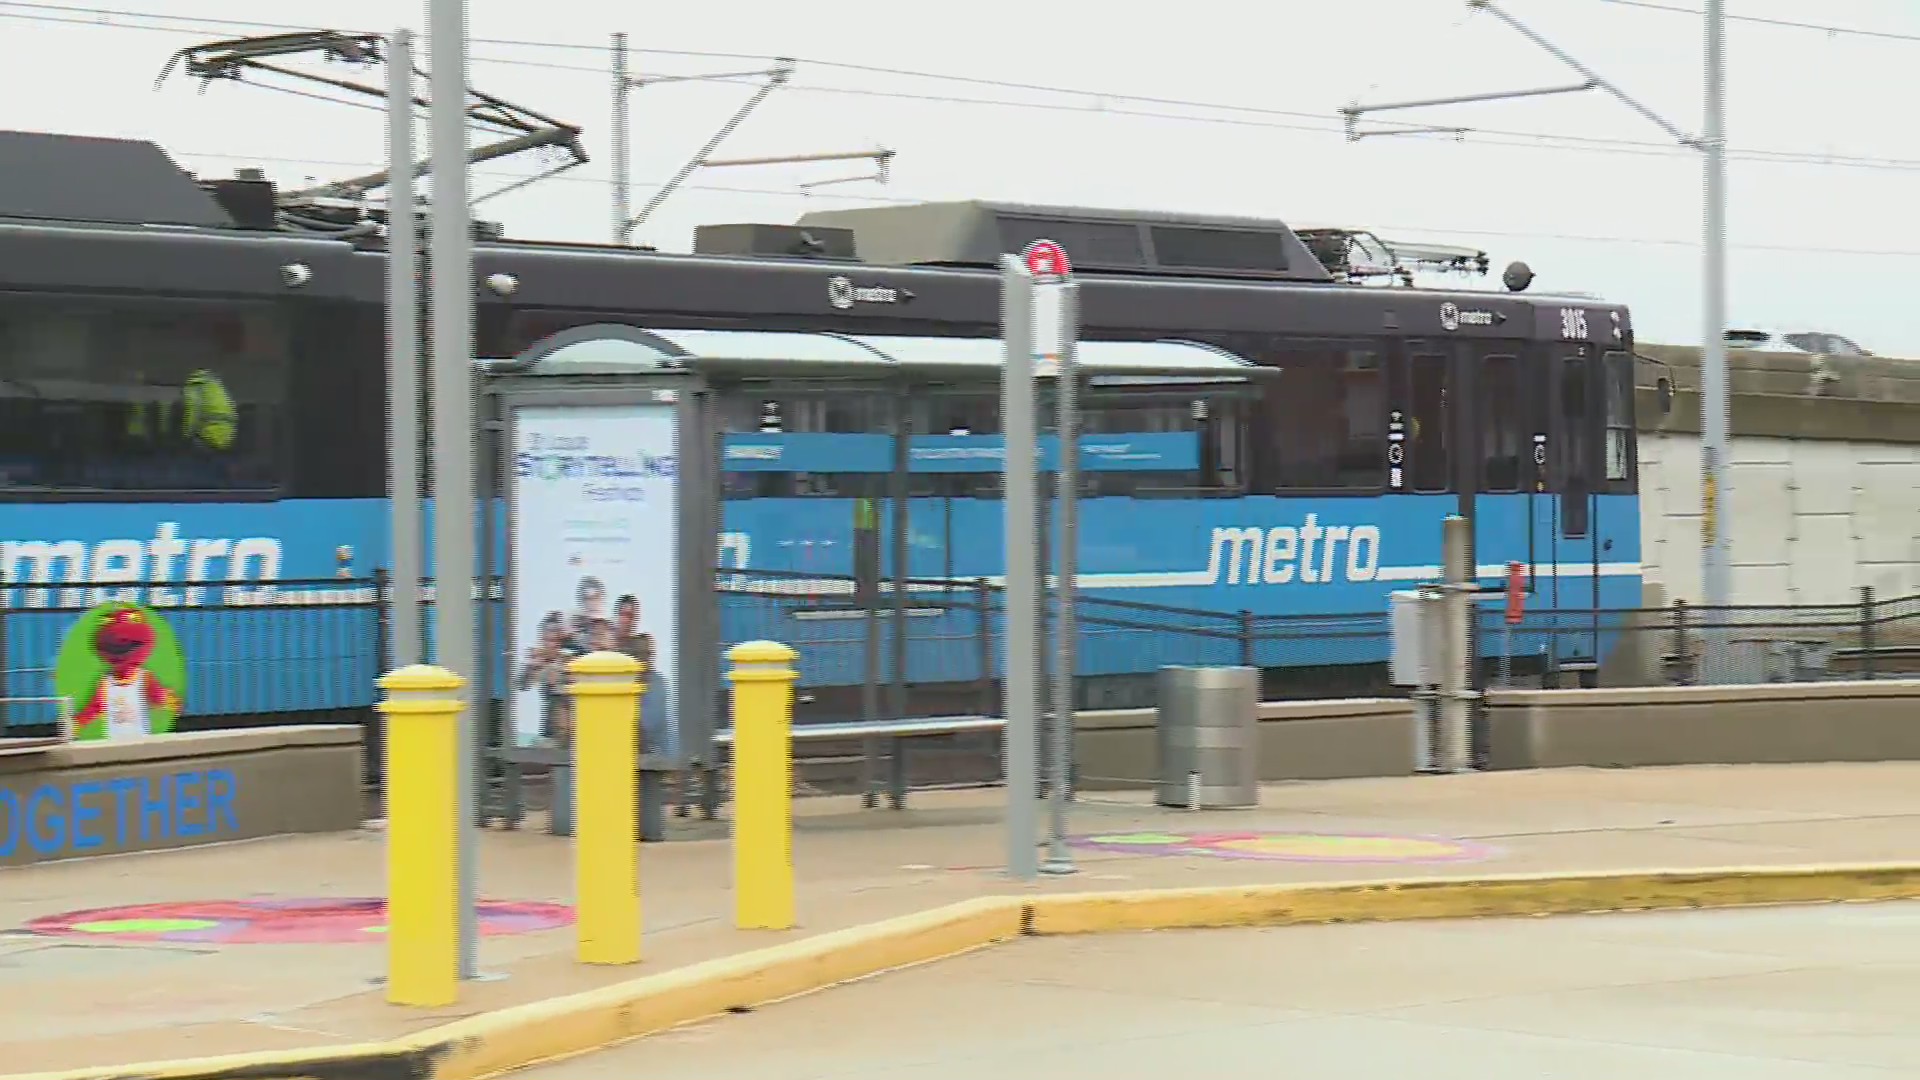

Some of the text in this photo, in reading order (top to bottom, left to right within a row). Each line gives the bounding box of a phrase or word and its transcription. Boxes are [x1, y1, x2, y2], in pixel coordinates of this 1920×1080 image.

[853, 286, 897, 303] metro
[1459, 308, 1494, 326] metro
[1559, 306, 1589, 340] 3015
[0, 521, 283, 608] metro
[1208, 512, 1382, 585] metro
